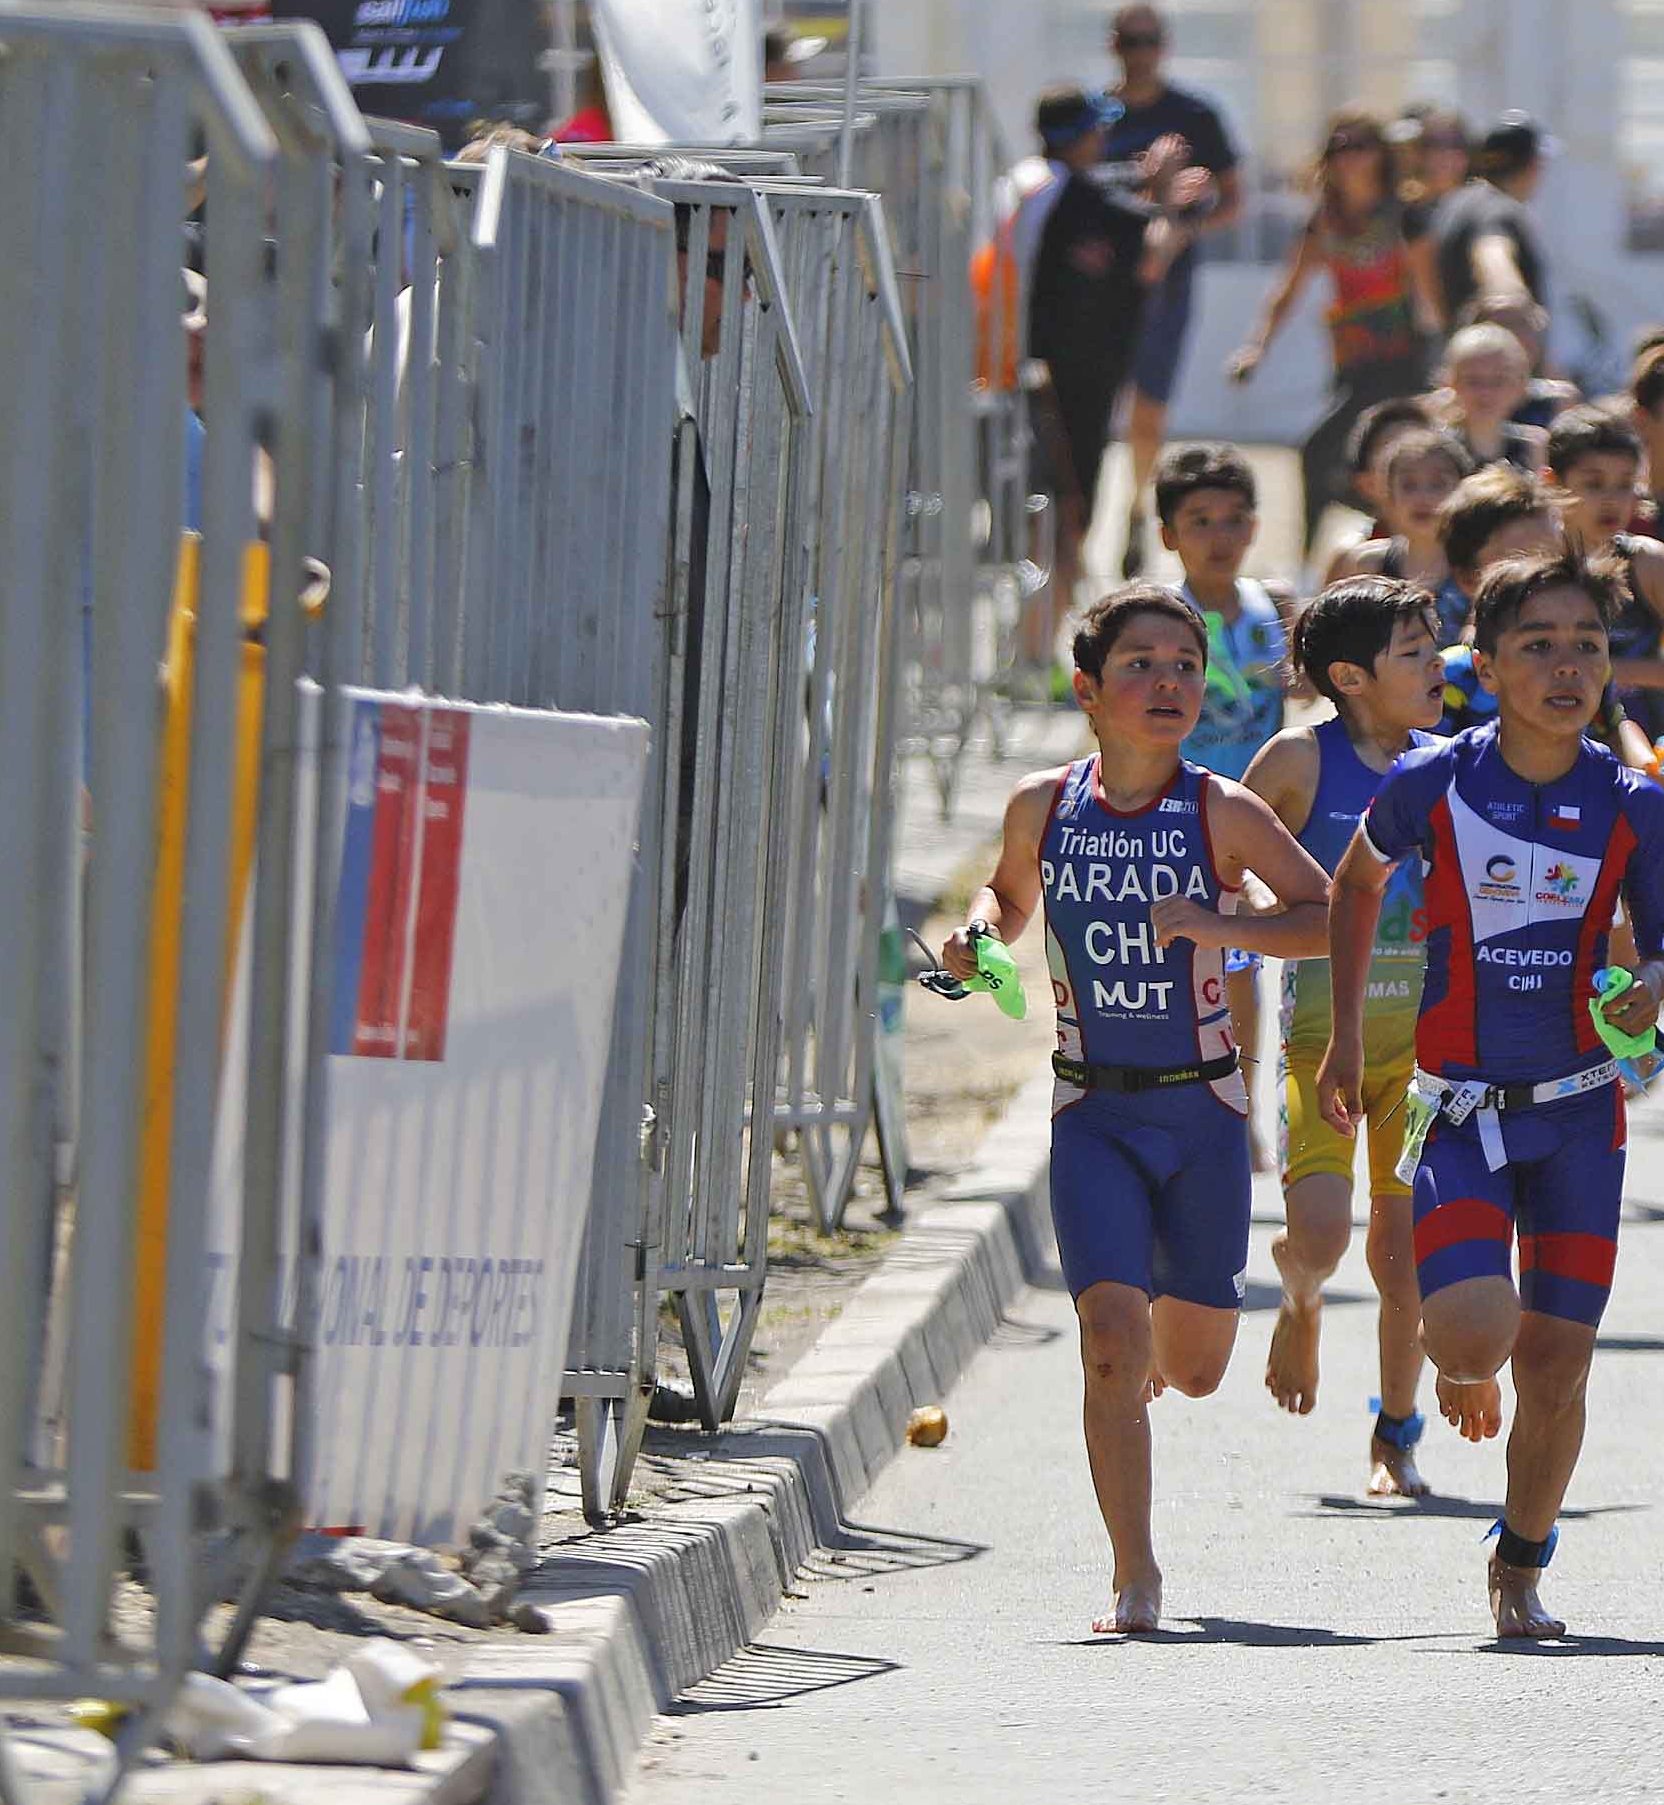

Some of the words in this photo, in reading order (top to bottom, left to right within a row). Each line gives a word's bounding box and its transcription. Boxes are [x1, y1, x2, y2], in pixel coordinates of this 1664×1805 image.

[1060, 826, 1144, 858] Triatlón
[1152, 829, 1188, 858] UC
[1041, 859, 1209, 903] PARADA
[1379, 898, 1428, 942] ds
[1085, 920, 1165, 965] CHI
[1477, 945, 1573, 967] ACEVEDO
[1093, 980, 1174, 1010] MUT
[1364, 980, 1410, 998] MAS
[430, 1256, 544, 1347] DEPORTES
